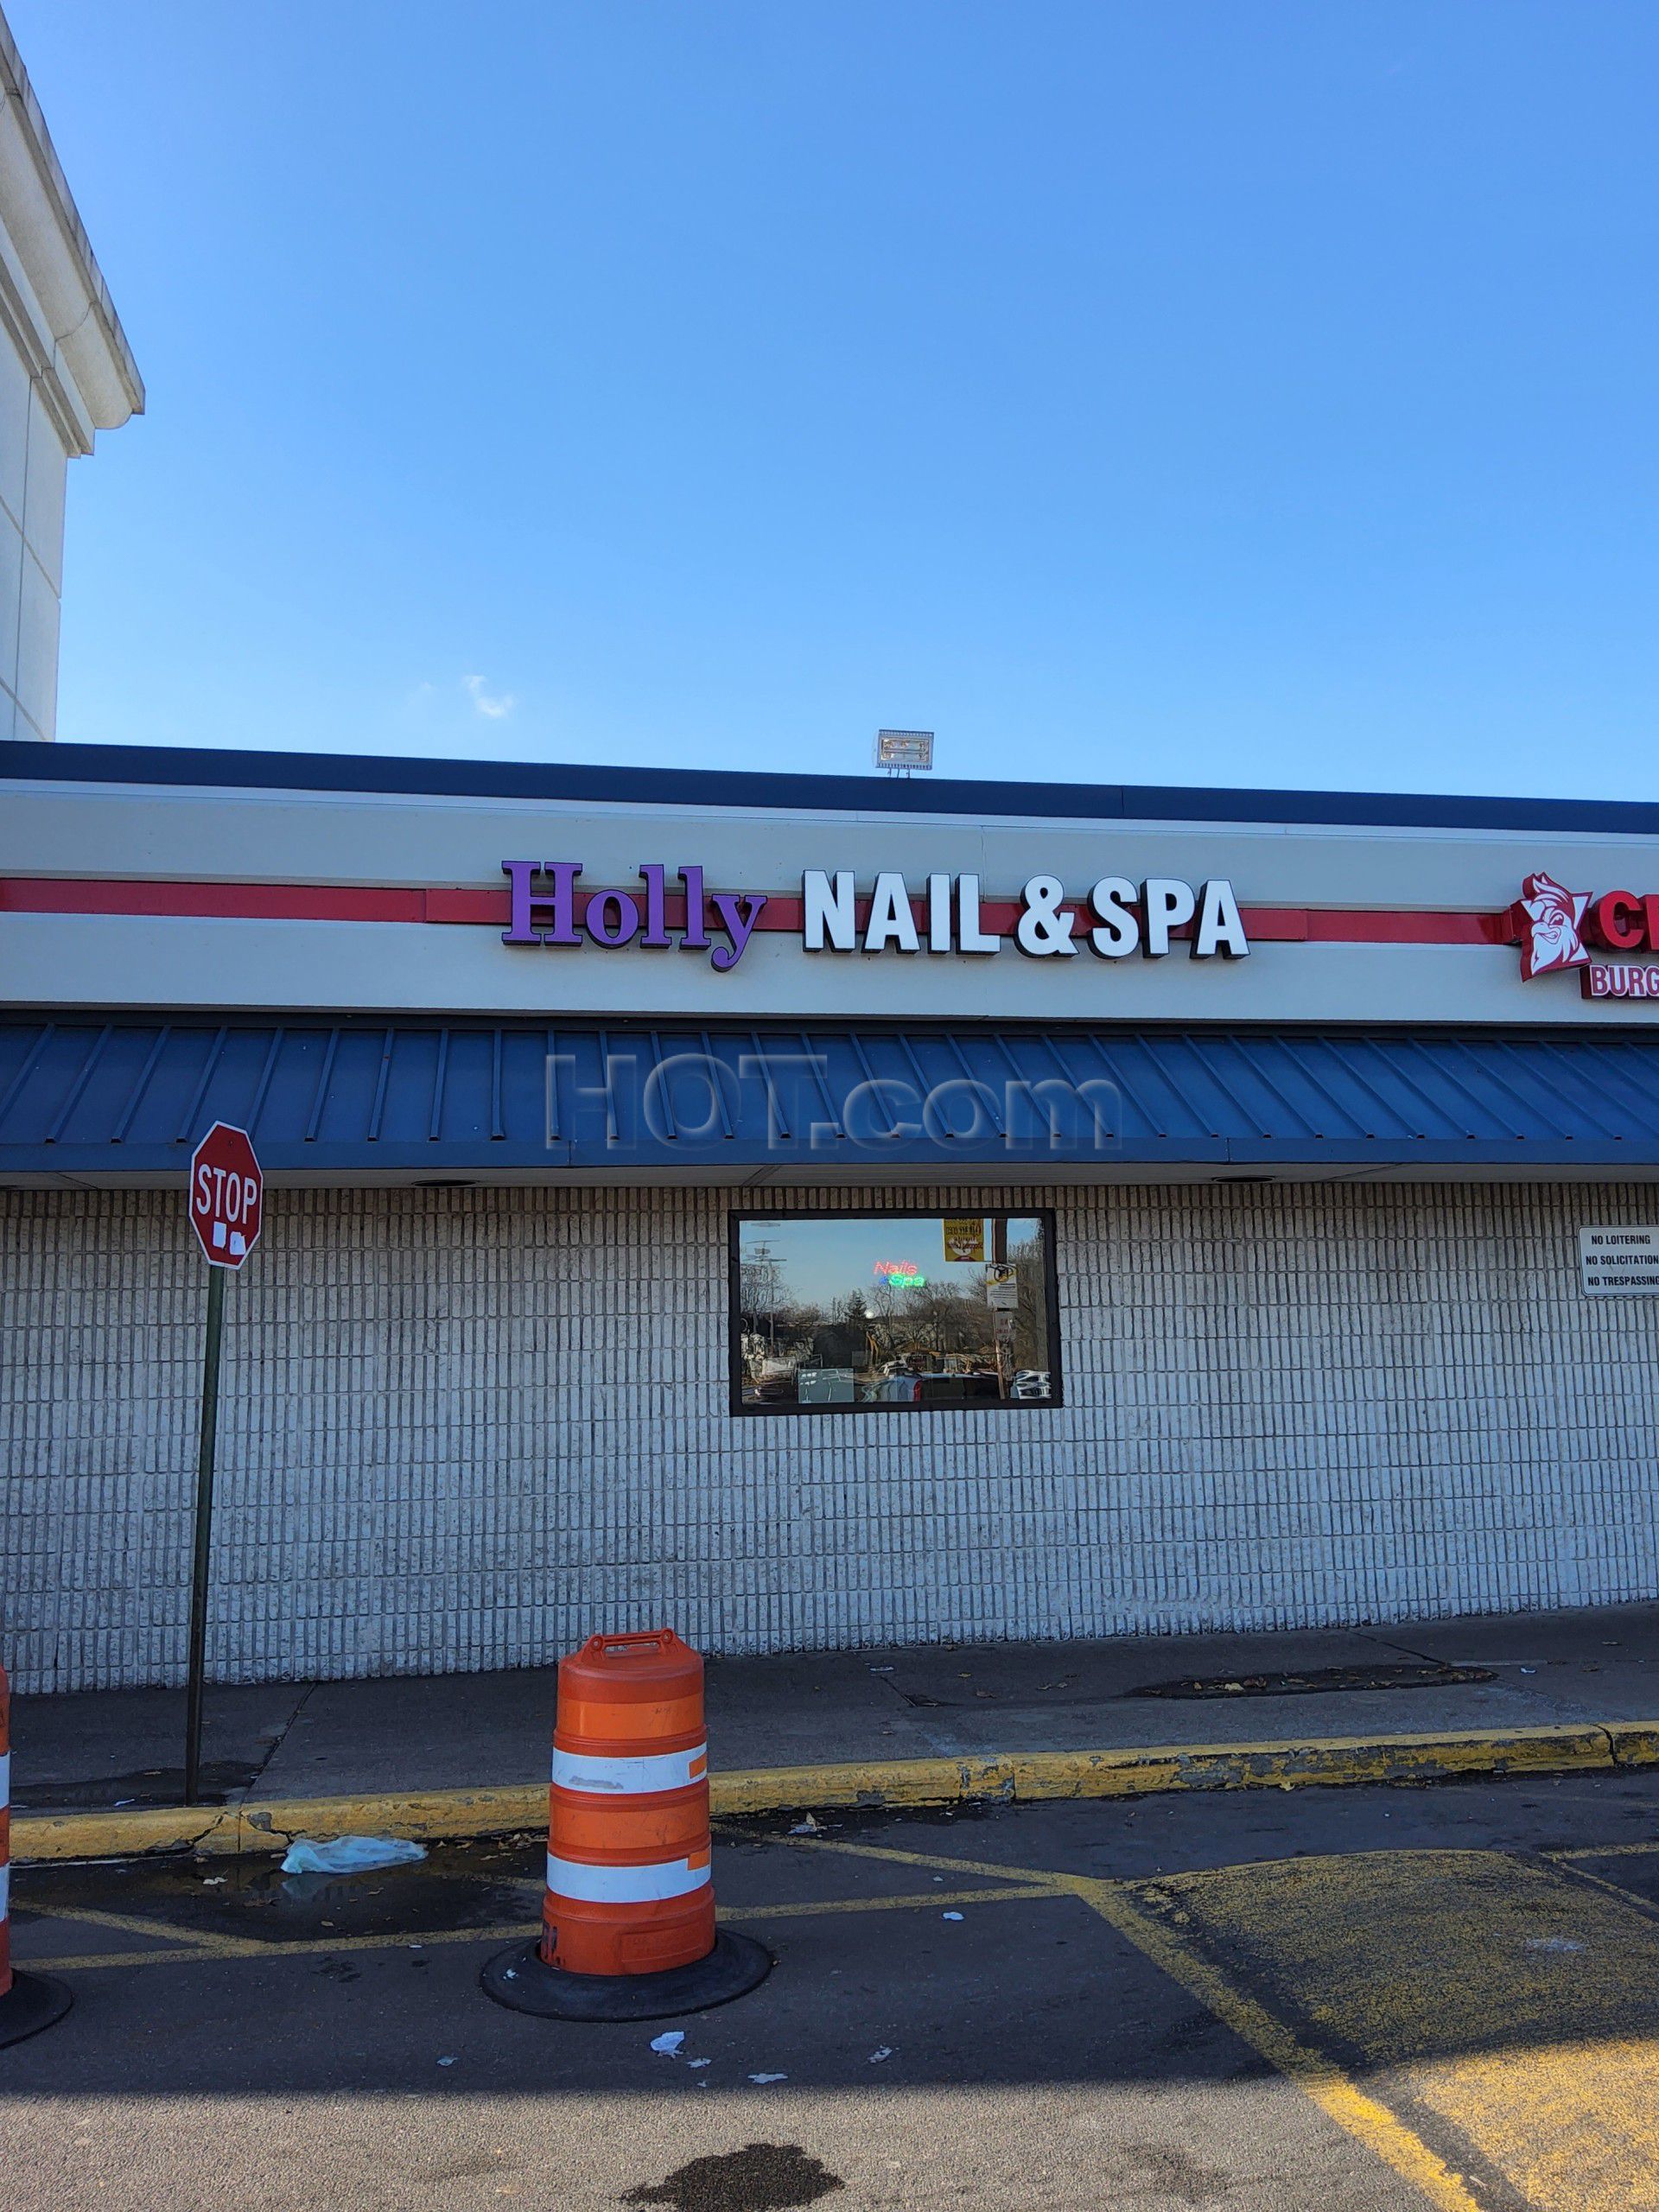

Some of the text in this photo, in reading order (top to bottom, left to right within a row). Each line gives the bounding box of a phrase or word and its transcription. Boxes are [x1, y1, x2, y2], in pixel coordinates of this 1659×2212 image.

[502, 861, 767, 972] Holly
[196, 1163, 257, 1224] STOP
[1592, 1235, 1651, 1244] NO LOITERING
[1586, 1255, 1658, 1265] NO SOLICITATION
[873, 1261, 918, 1275] Nails
[889, 1274, 925, 1288] Spa
[1587, 1276, 1600, 1286] NO
